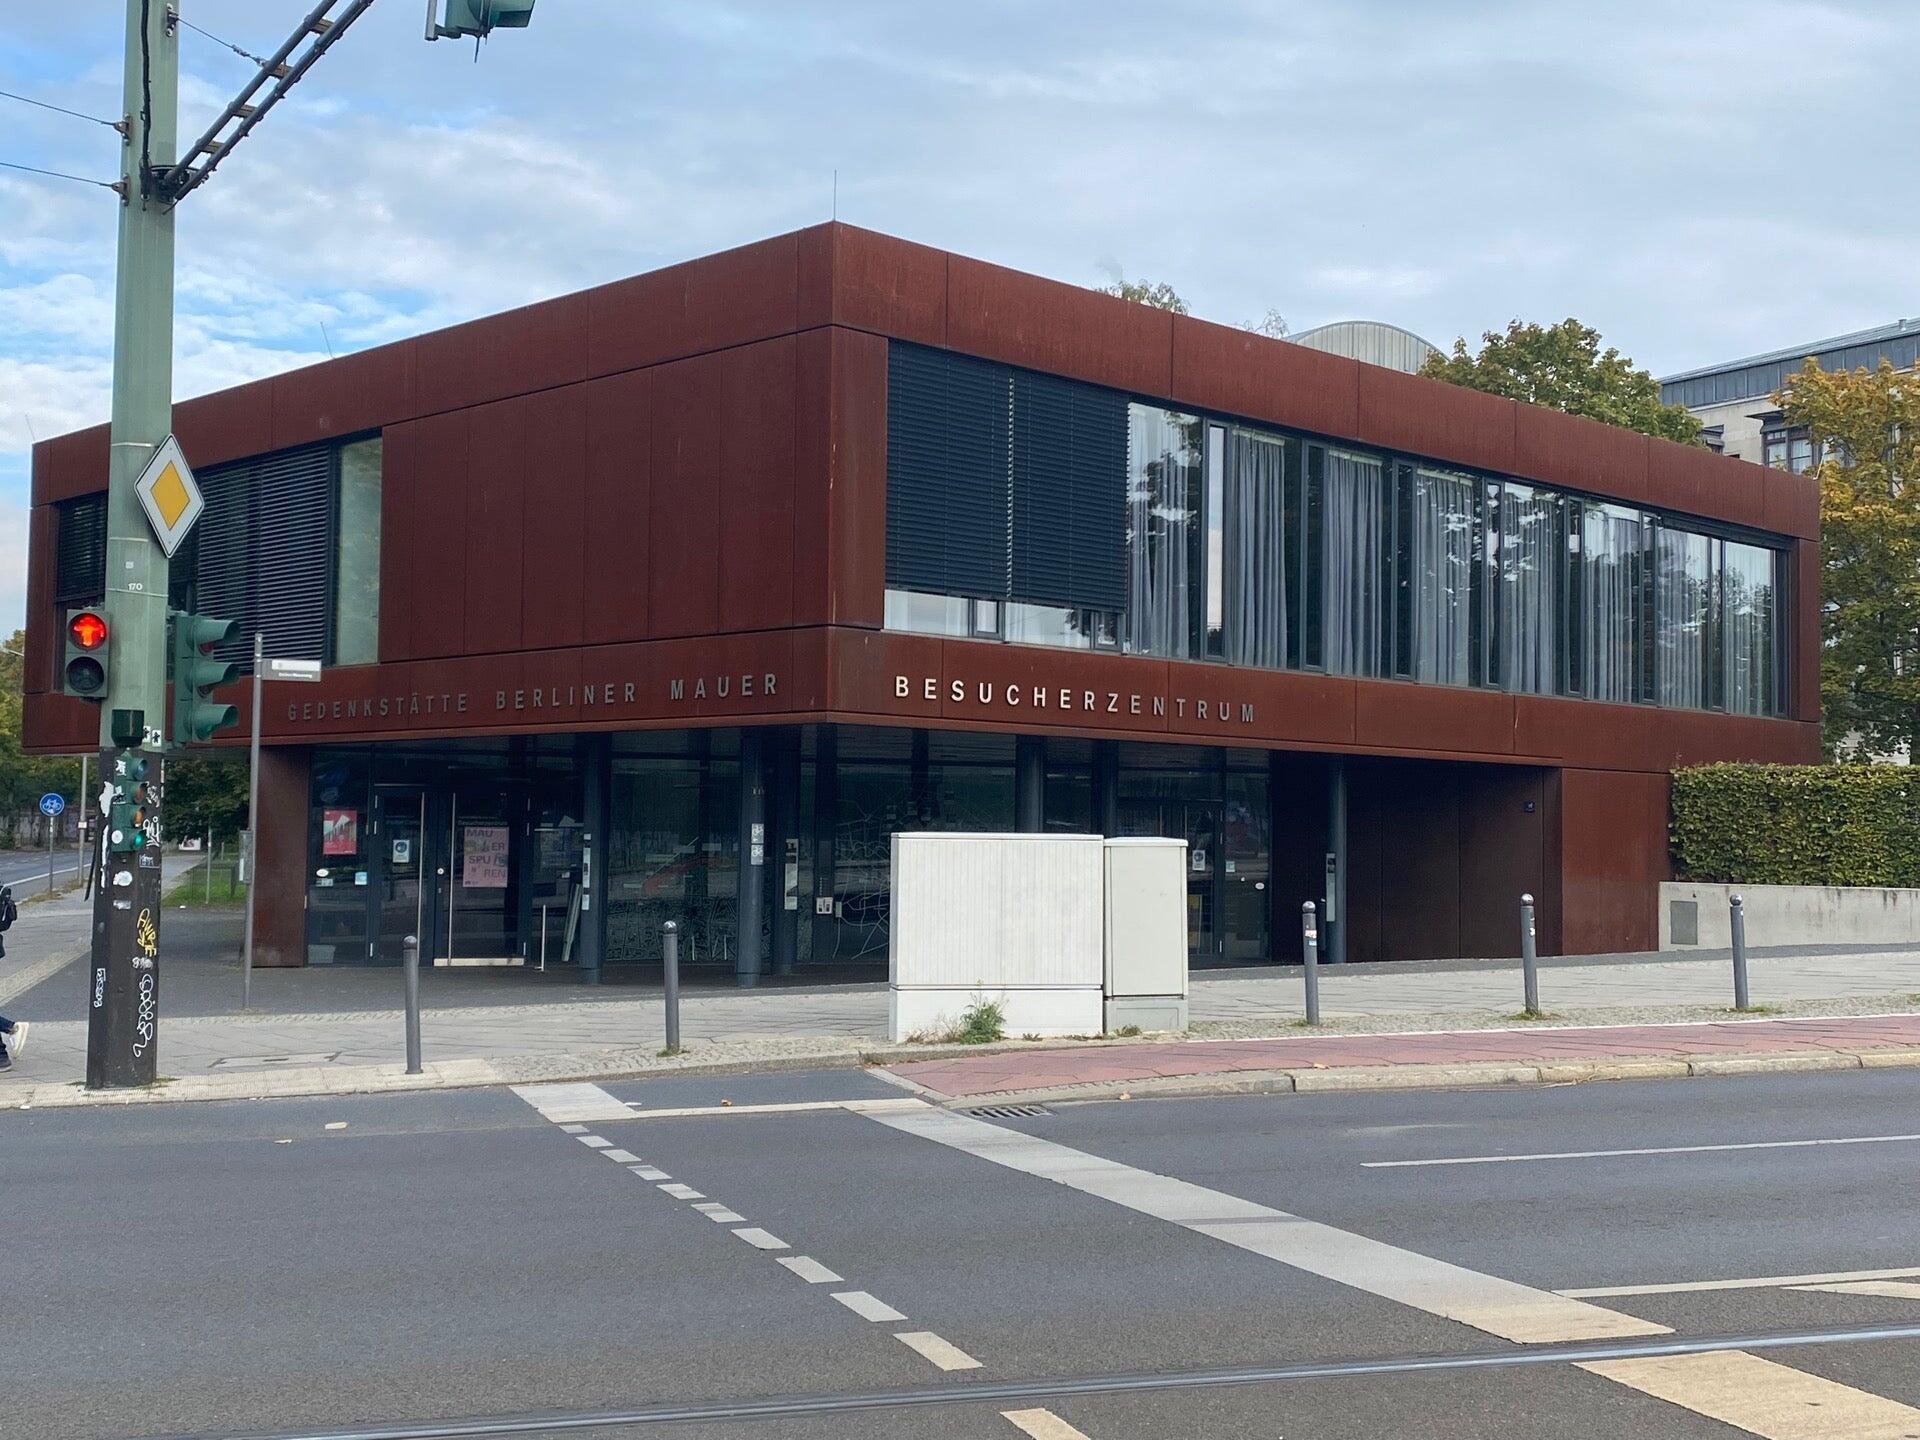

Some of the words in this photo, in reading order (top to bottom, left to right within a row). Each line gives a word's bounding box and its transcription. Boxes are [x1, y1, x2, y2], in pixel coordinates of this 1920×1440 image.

[128, 583, 143, 591] 170
[288, 692, 468, 721] GEDENKSTÄTTE
[496, 683, 635, 710] BERLINER
[671, 673, 777, 700] MAUER
[895, 676, 1254, 723] BESUCHERZENTRUM
[466, 829, 494, 838] MAU
[468, 855, 491, 865] SPU
[484, 868, 506, 879] REN
